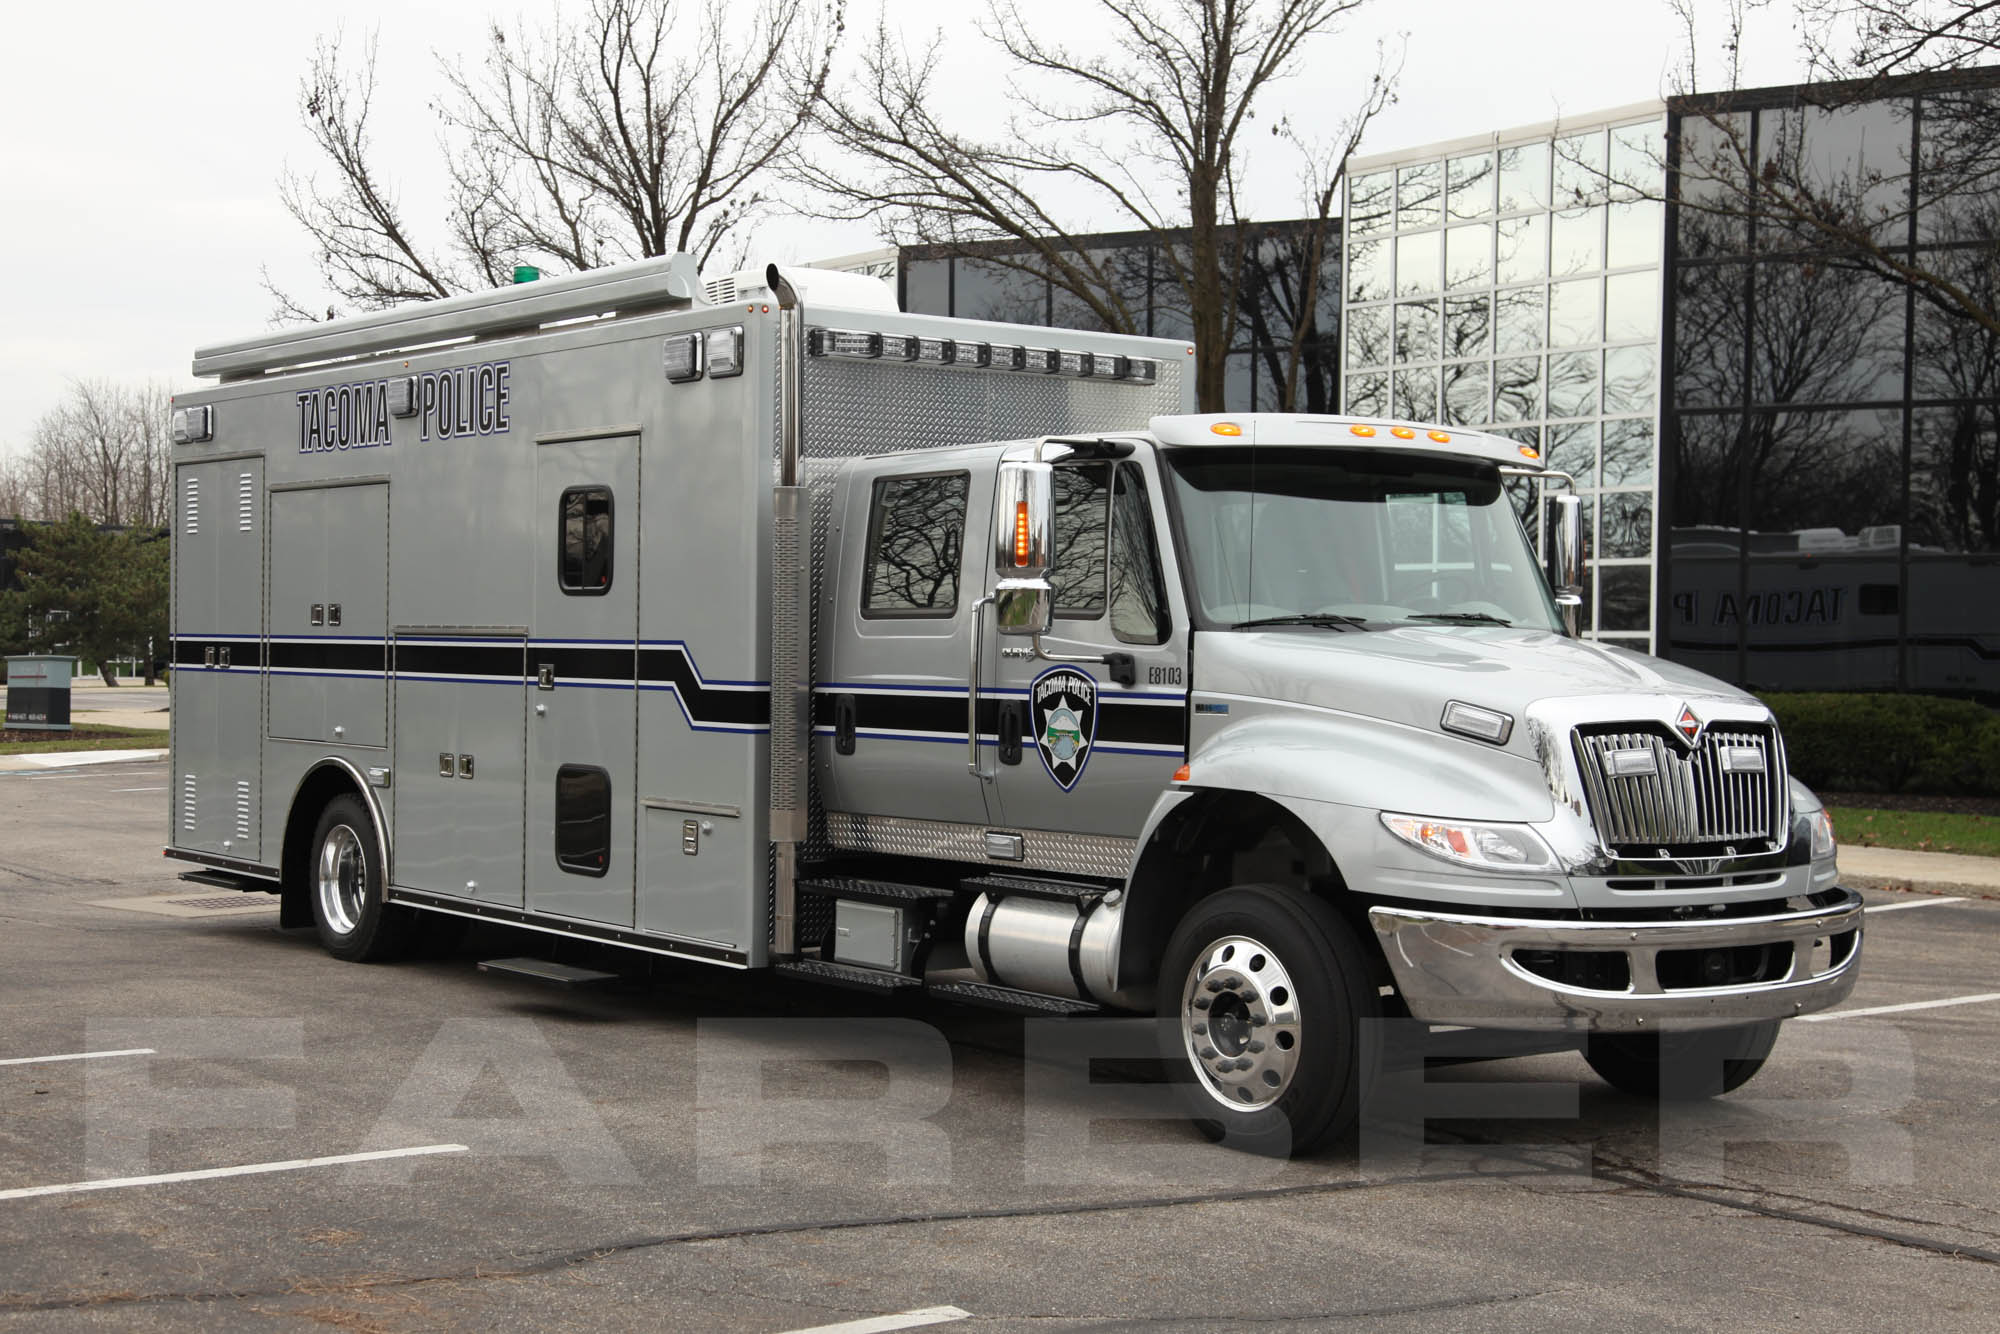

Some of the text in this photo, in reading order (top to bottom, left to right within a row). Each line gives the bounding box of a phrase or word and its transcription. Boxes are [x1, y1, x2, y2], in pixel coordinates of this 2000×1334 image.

[297, 361, 510, 454] TACOMA POLICE
[1037, 675, 1091, 706] TACOMA POLICE
[1149, 666, 1182, 685] E8103
